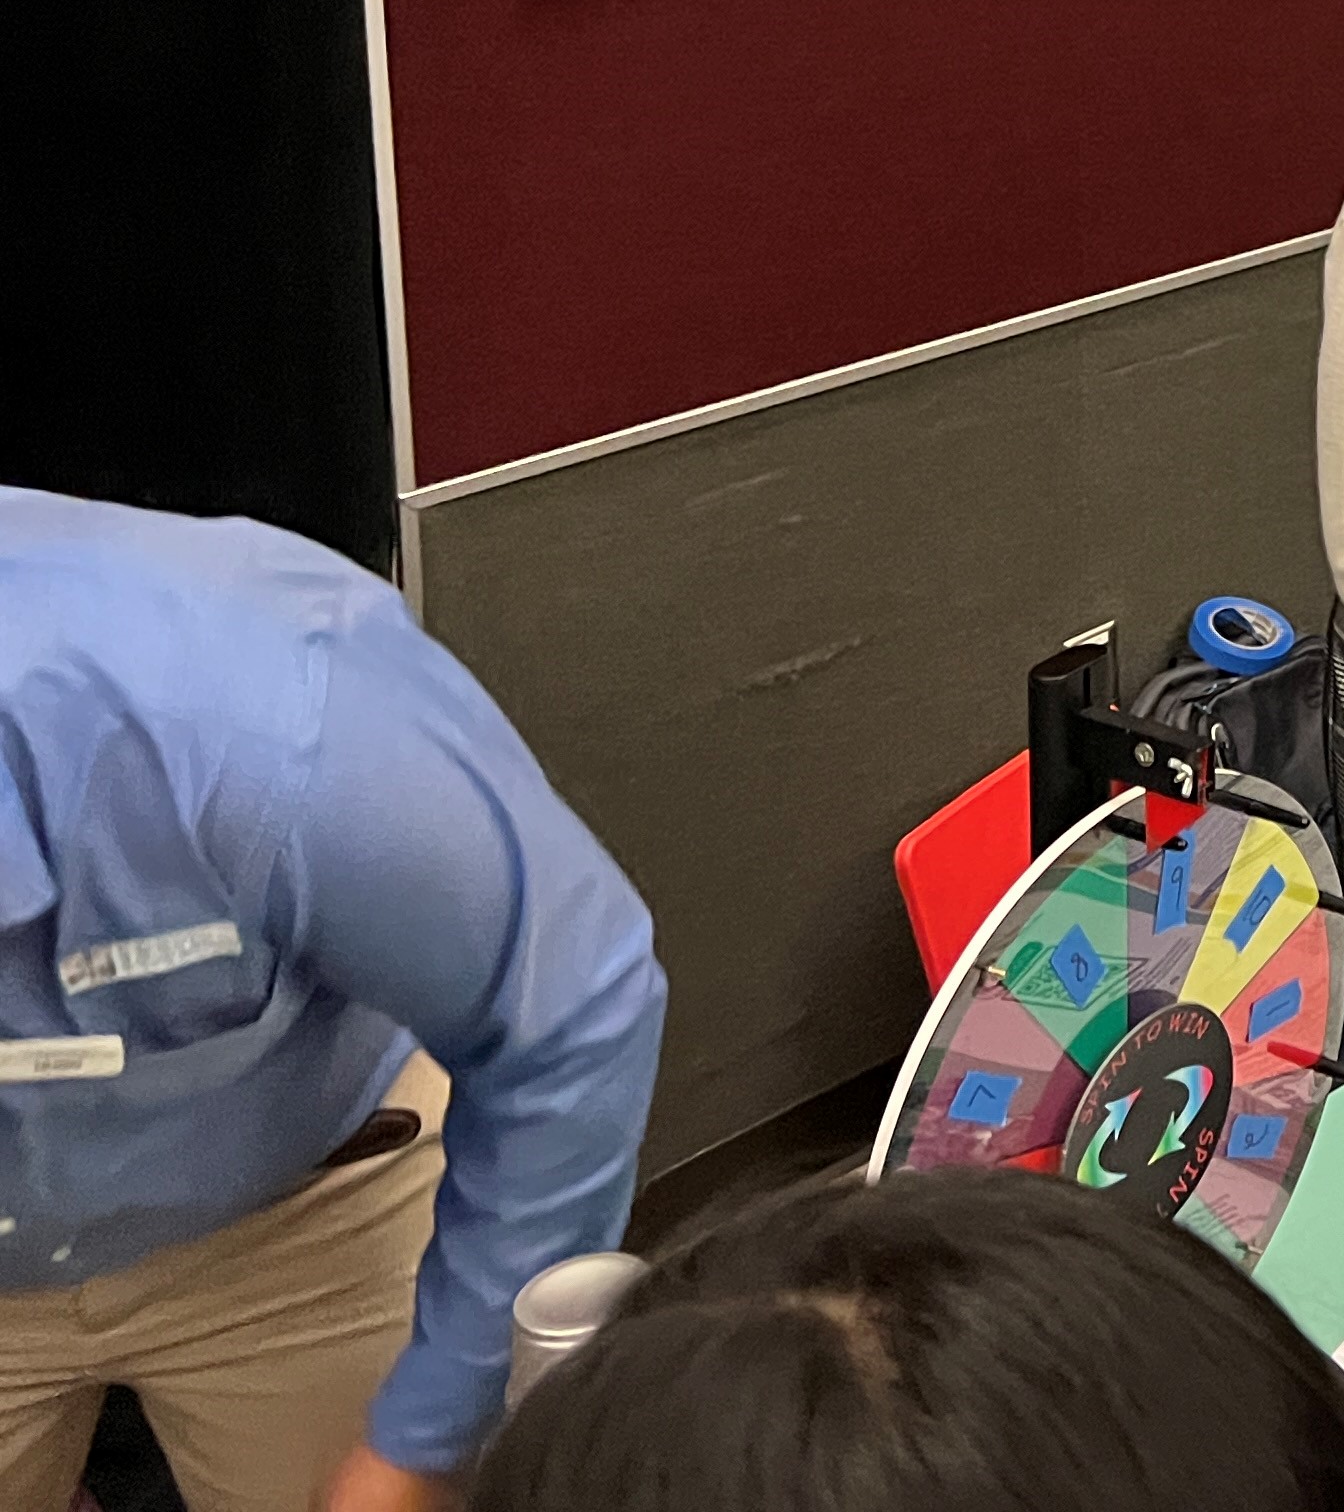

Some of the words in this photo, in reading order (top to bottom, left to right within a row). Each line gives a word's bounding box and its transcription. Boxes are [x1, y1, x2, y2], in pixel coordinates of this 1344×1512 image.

[1171, 866, 1183, 912] 9
[1242, 890, 1271, 925] 10
[1079, 1051, 1127, 1125] SPIN
[1134, 1019, 1163, 1050] TO
[1169, 1012, 1211, 1040] WIN
[967, 1084, 996, 1107] 7
[1169, 1127, 1214, 1204] SPIN
